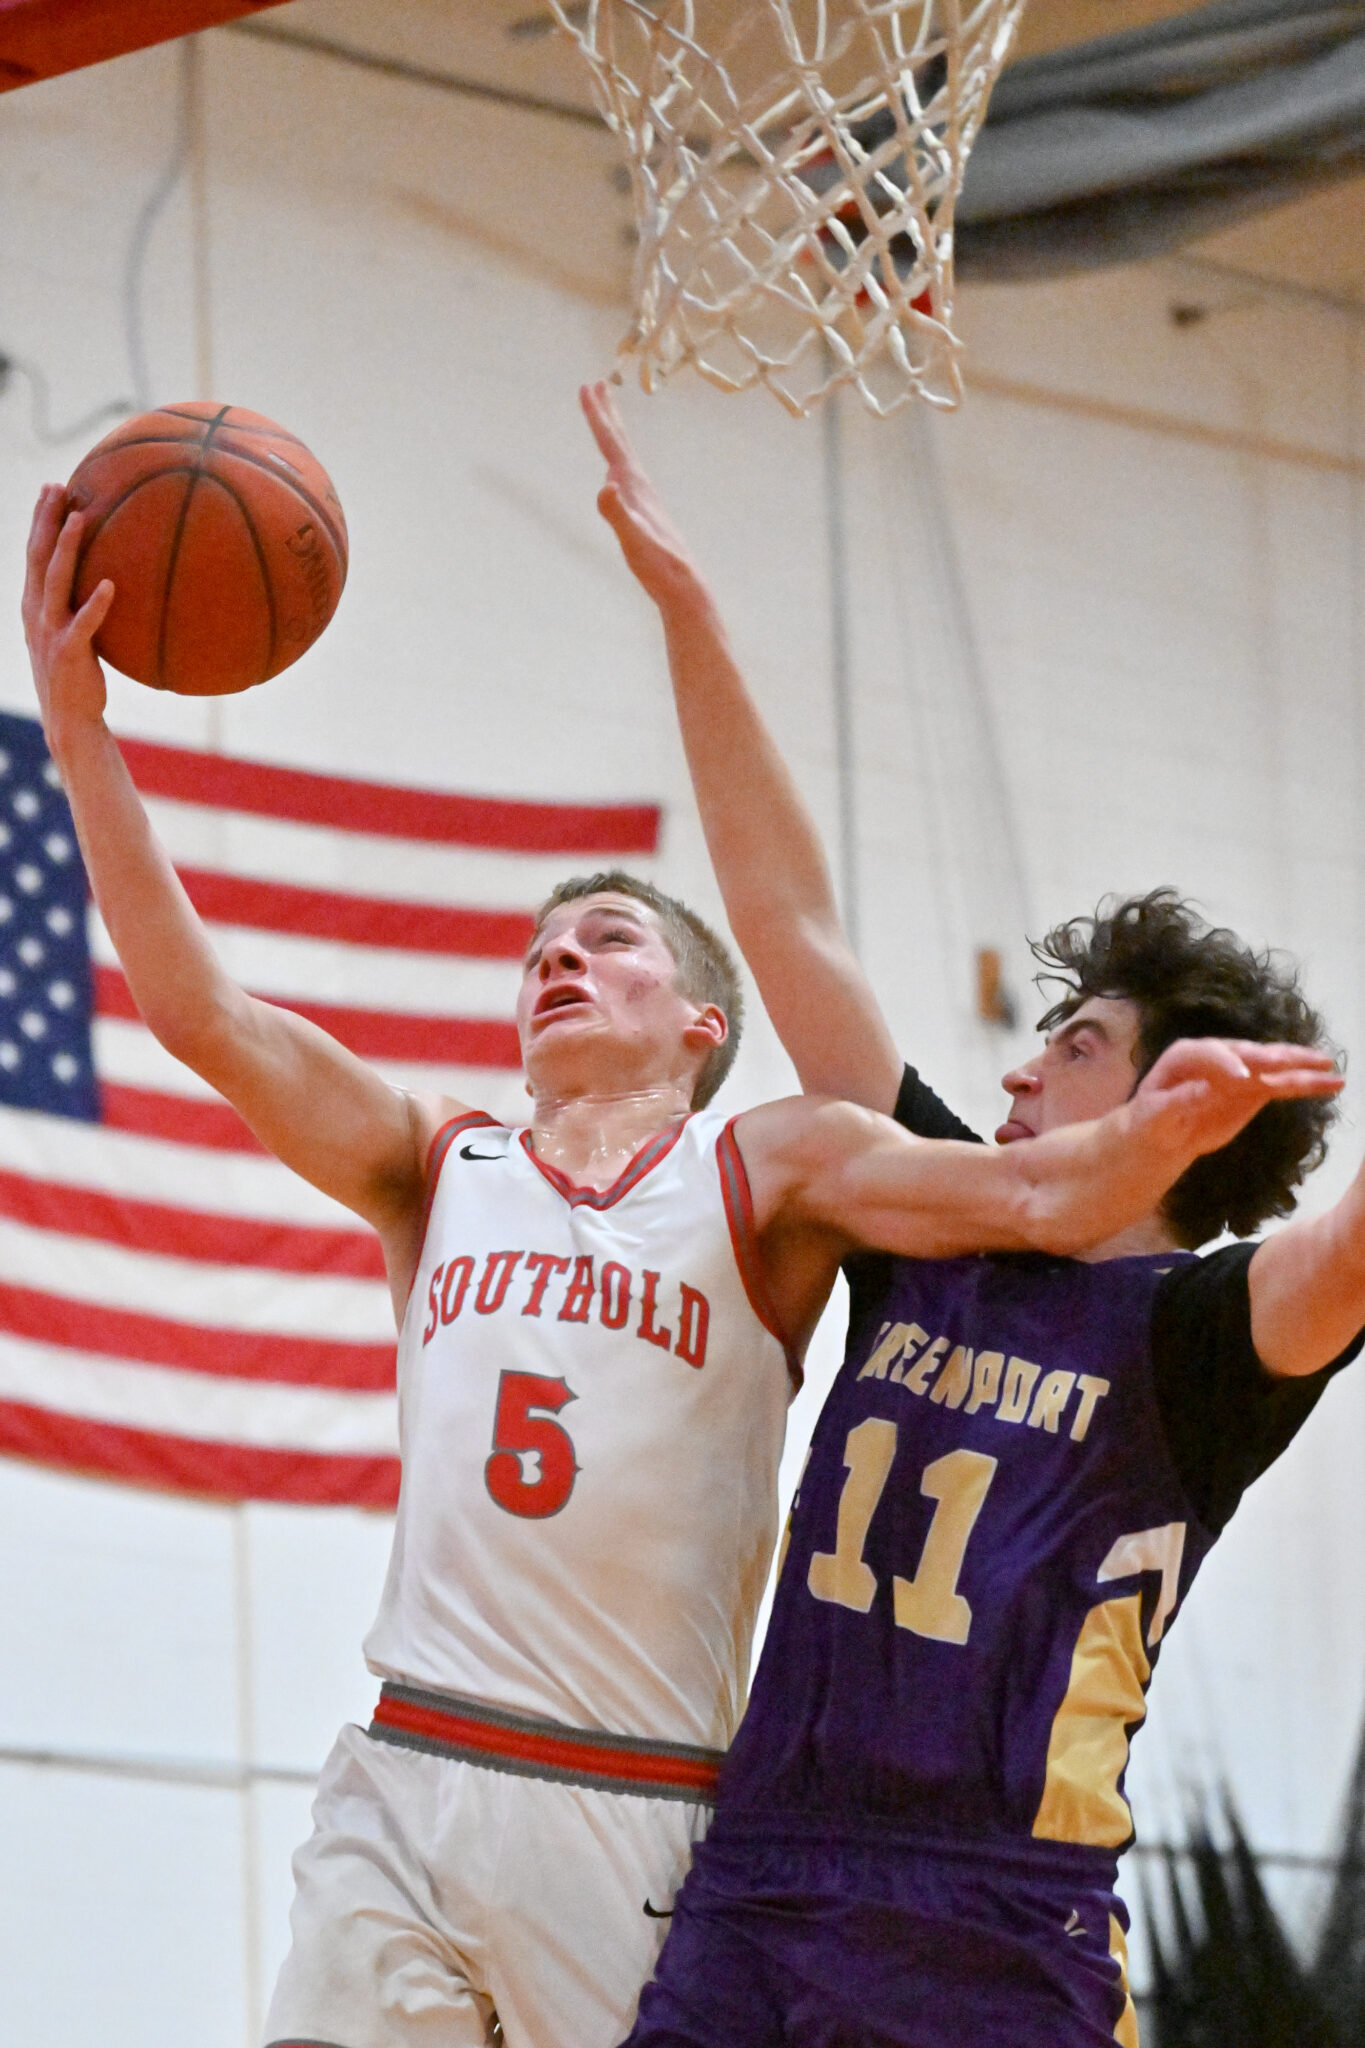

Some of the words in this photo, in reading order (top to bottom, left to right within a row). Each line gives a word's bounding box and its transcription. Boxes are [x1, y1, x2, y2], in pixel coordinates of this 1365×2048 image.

[423, 1250, 710, 1369] SOUTHOLD
[484, 1368, 583, 1520] 5
[856, 1321, 1111, 1442] REENPORT
[807, 1416, 998, 1645] 11
